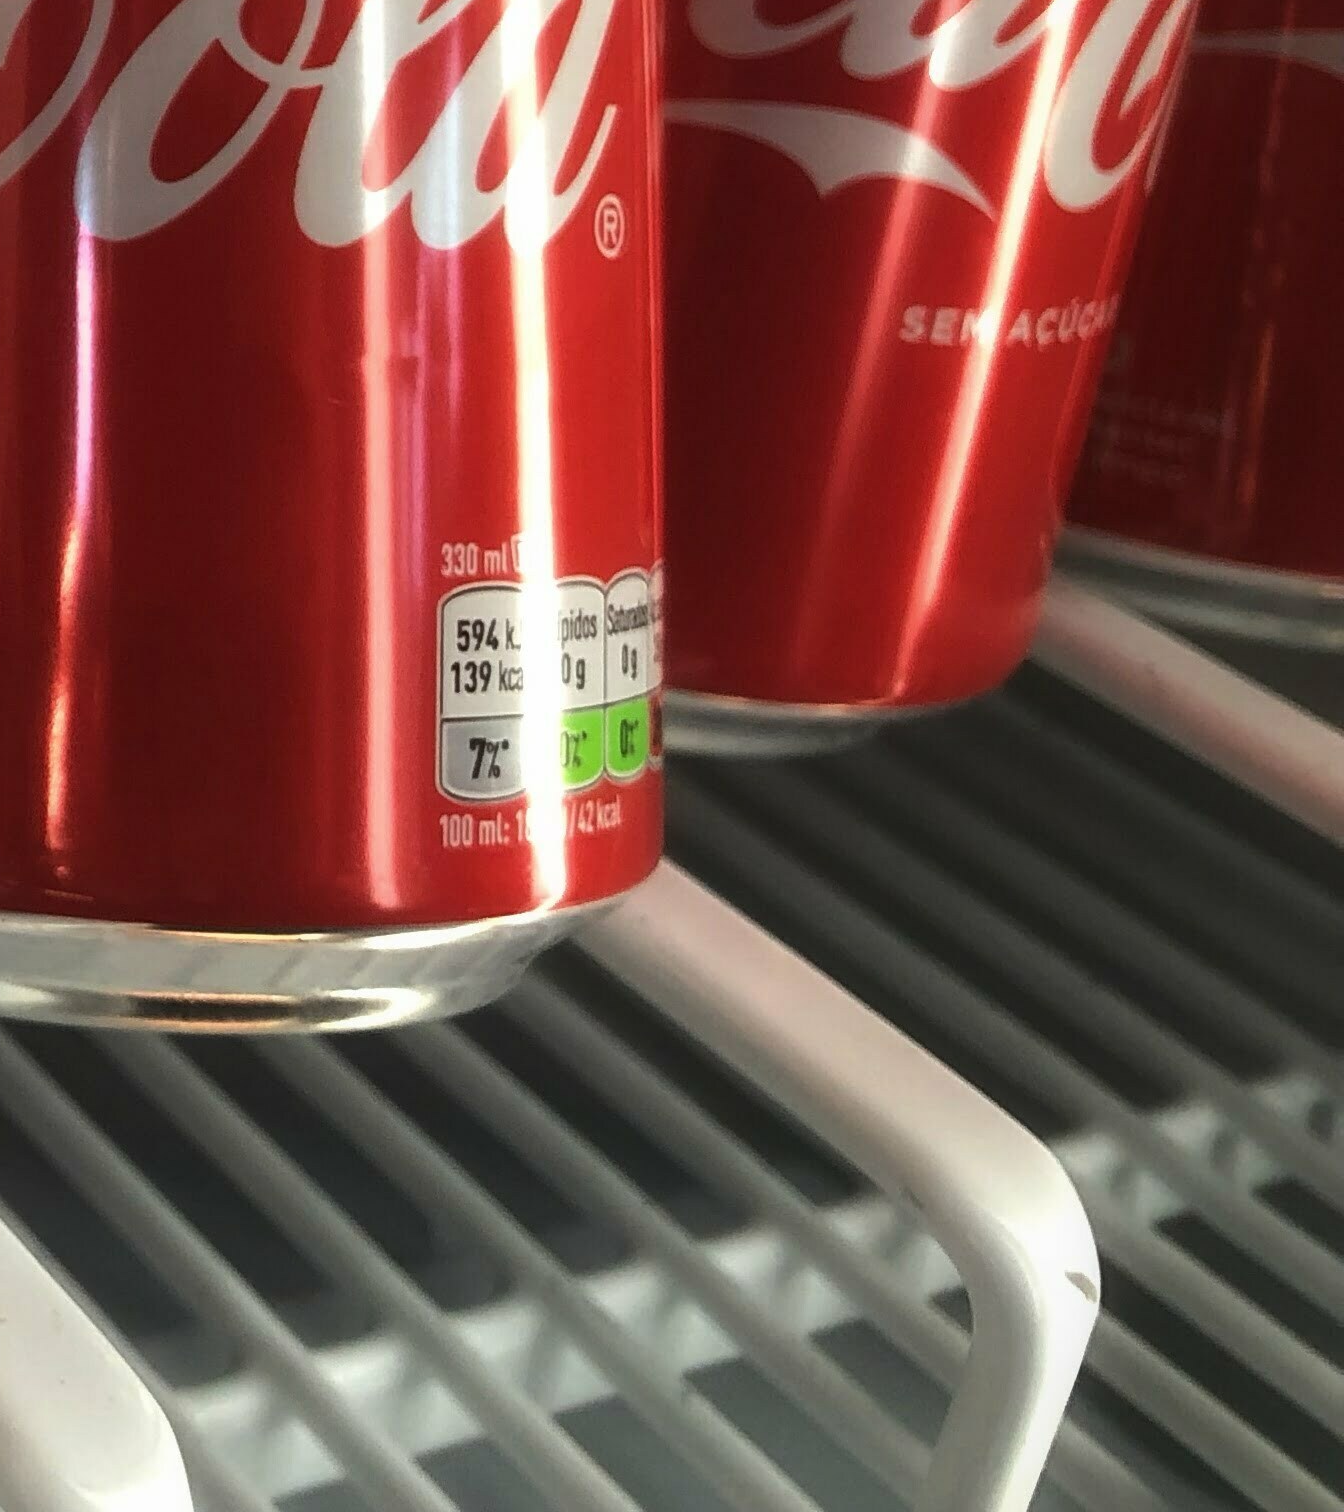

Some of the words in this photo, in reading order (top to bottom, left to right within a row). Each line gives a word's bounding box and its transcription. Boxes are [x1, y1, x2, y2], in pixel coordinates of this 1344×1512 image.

[440, 542, 479, 577] 330
[483, 541, 508, 575] ml
[456, 618, 500, 653] 594
[450, 660, 492, 694] 139
[439, 813, 474, 849] 100
[478, 812, 510, 847] ml:
